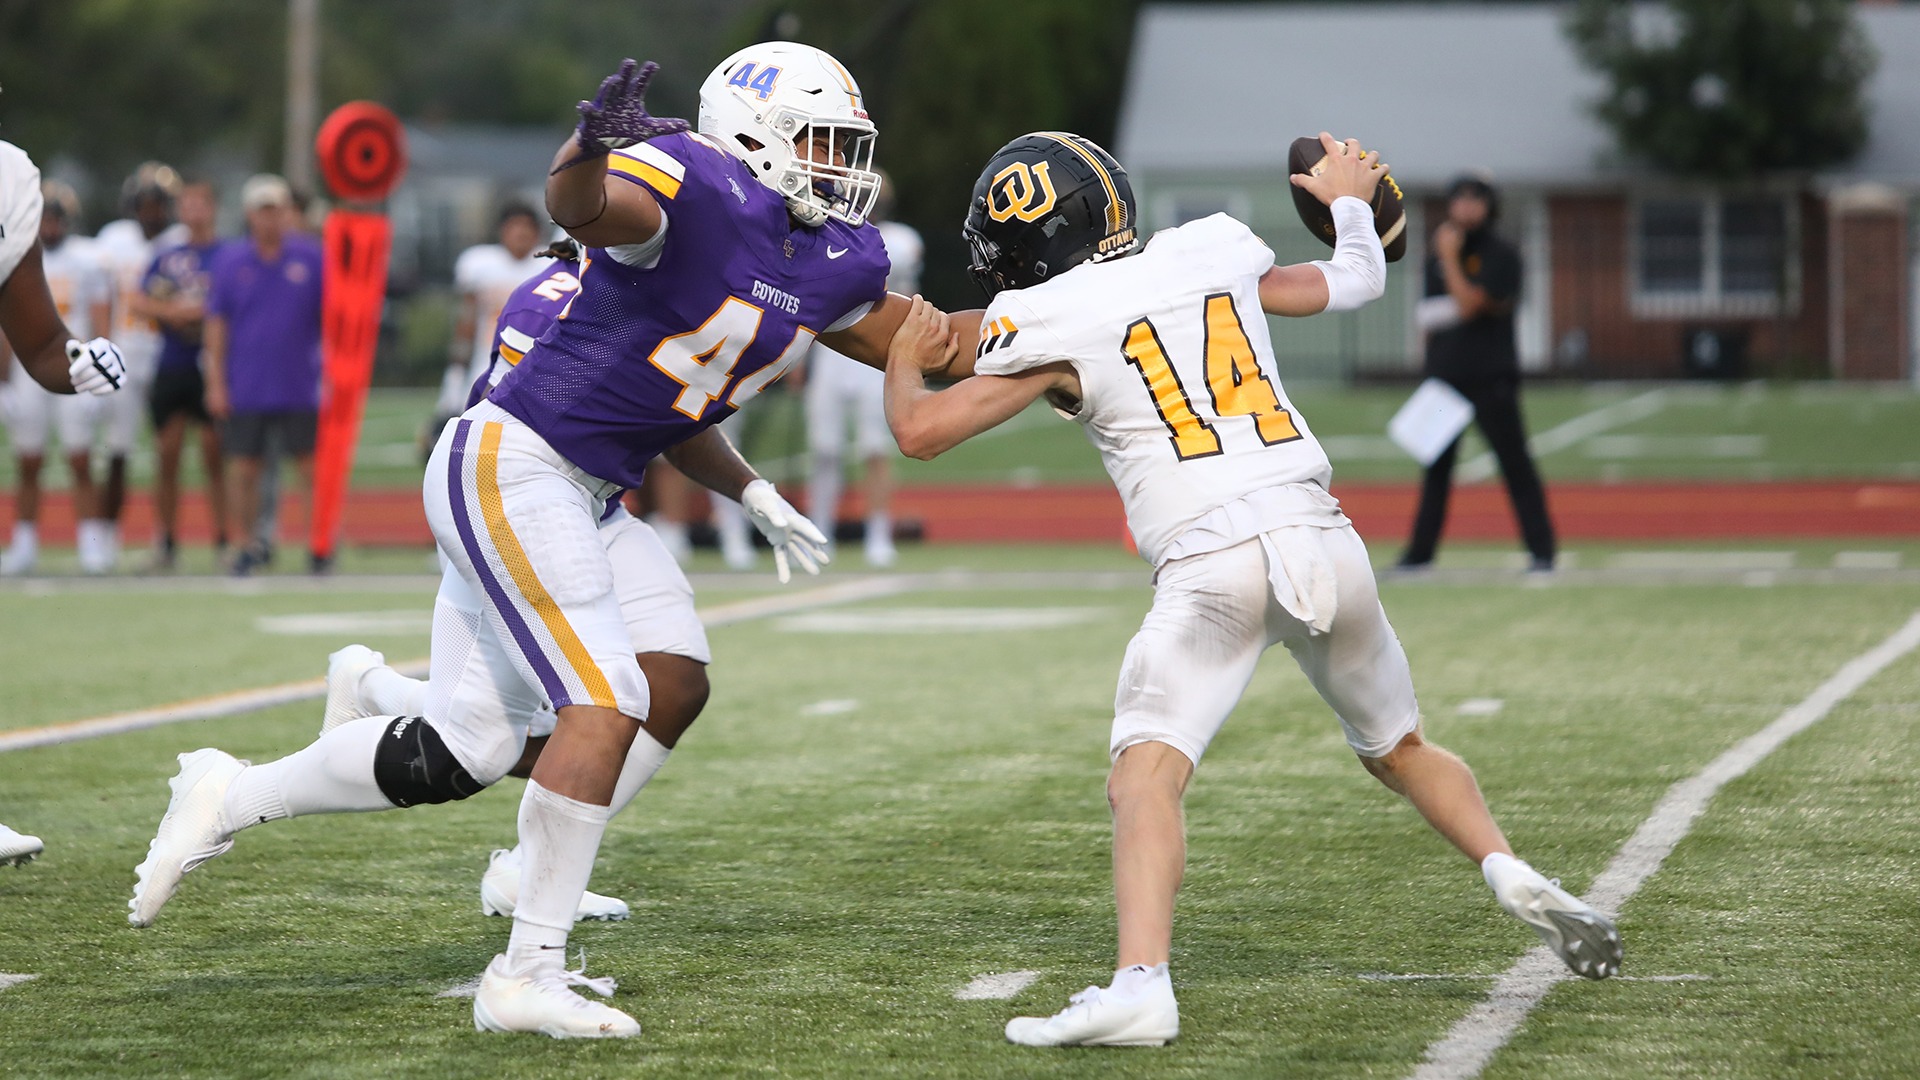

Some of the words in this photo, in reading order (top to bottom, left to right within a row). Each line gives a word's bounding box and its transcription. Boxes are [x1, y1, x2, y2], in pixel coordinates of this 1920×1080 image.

[725, 61, 784, 102] 44
[853, 109, 870, 120] Ridde
[987, 161, 1058, 223] OU
[1098, 228, 1133, 253] OTTAWA
[751, 279, 800, 315] COYOTES
[1120, 291, 1304, 462] 14
